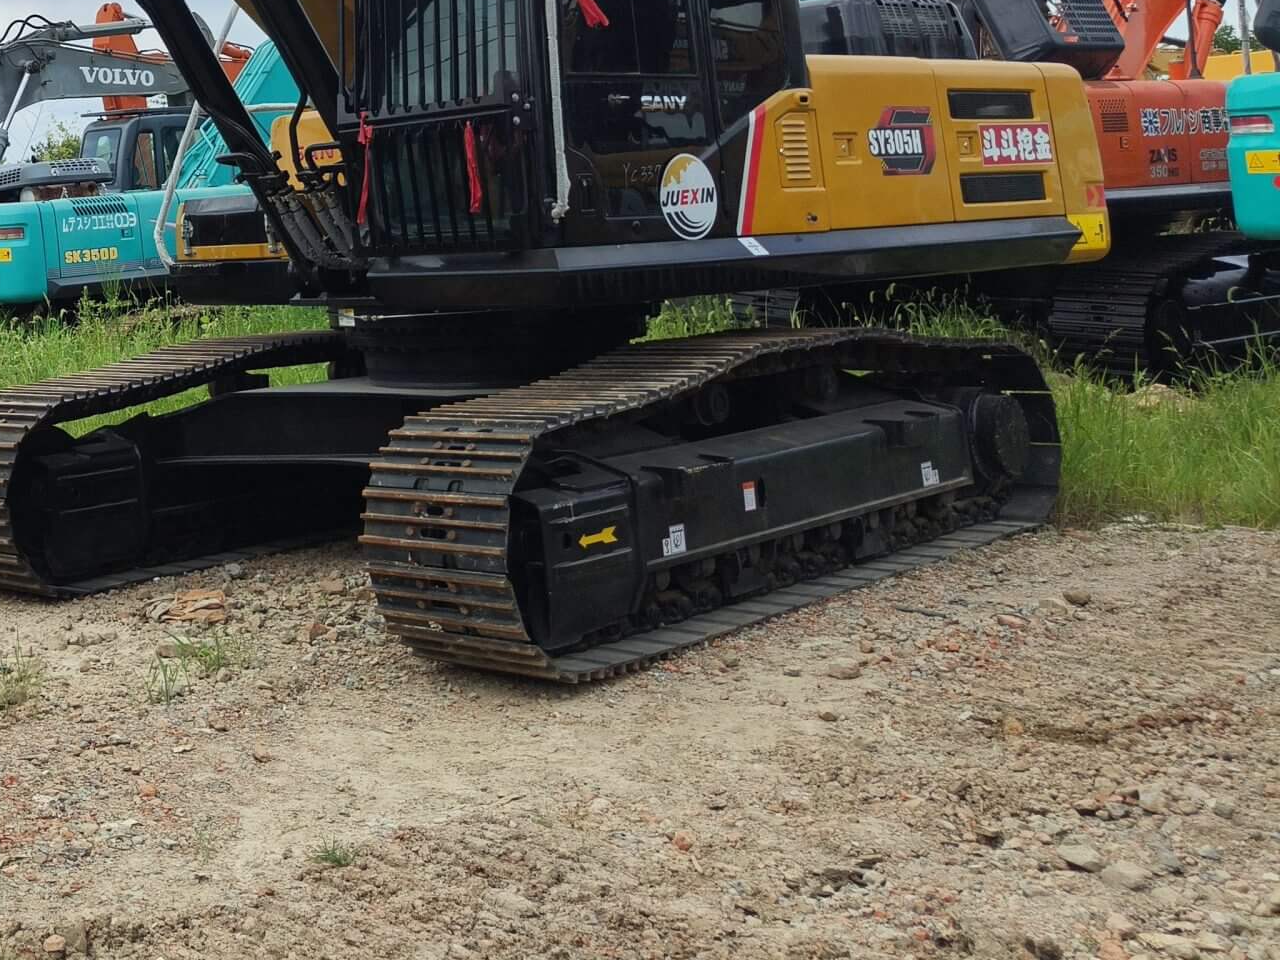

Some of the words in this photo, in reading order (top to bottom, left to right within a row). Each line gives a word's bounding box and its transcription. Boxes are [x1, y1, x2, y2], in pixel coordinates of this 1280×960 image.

[79, 65, 155, 87] VOLVO
[640, 95, 687, 111] SANY
[869, 128, 923, 156] SY305H
[662, 187, 715, 208] JUEXIN
